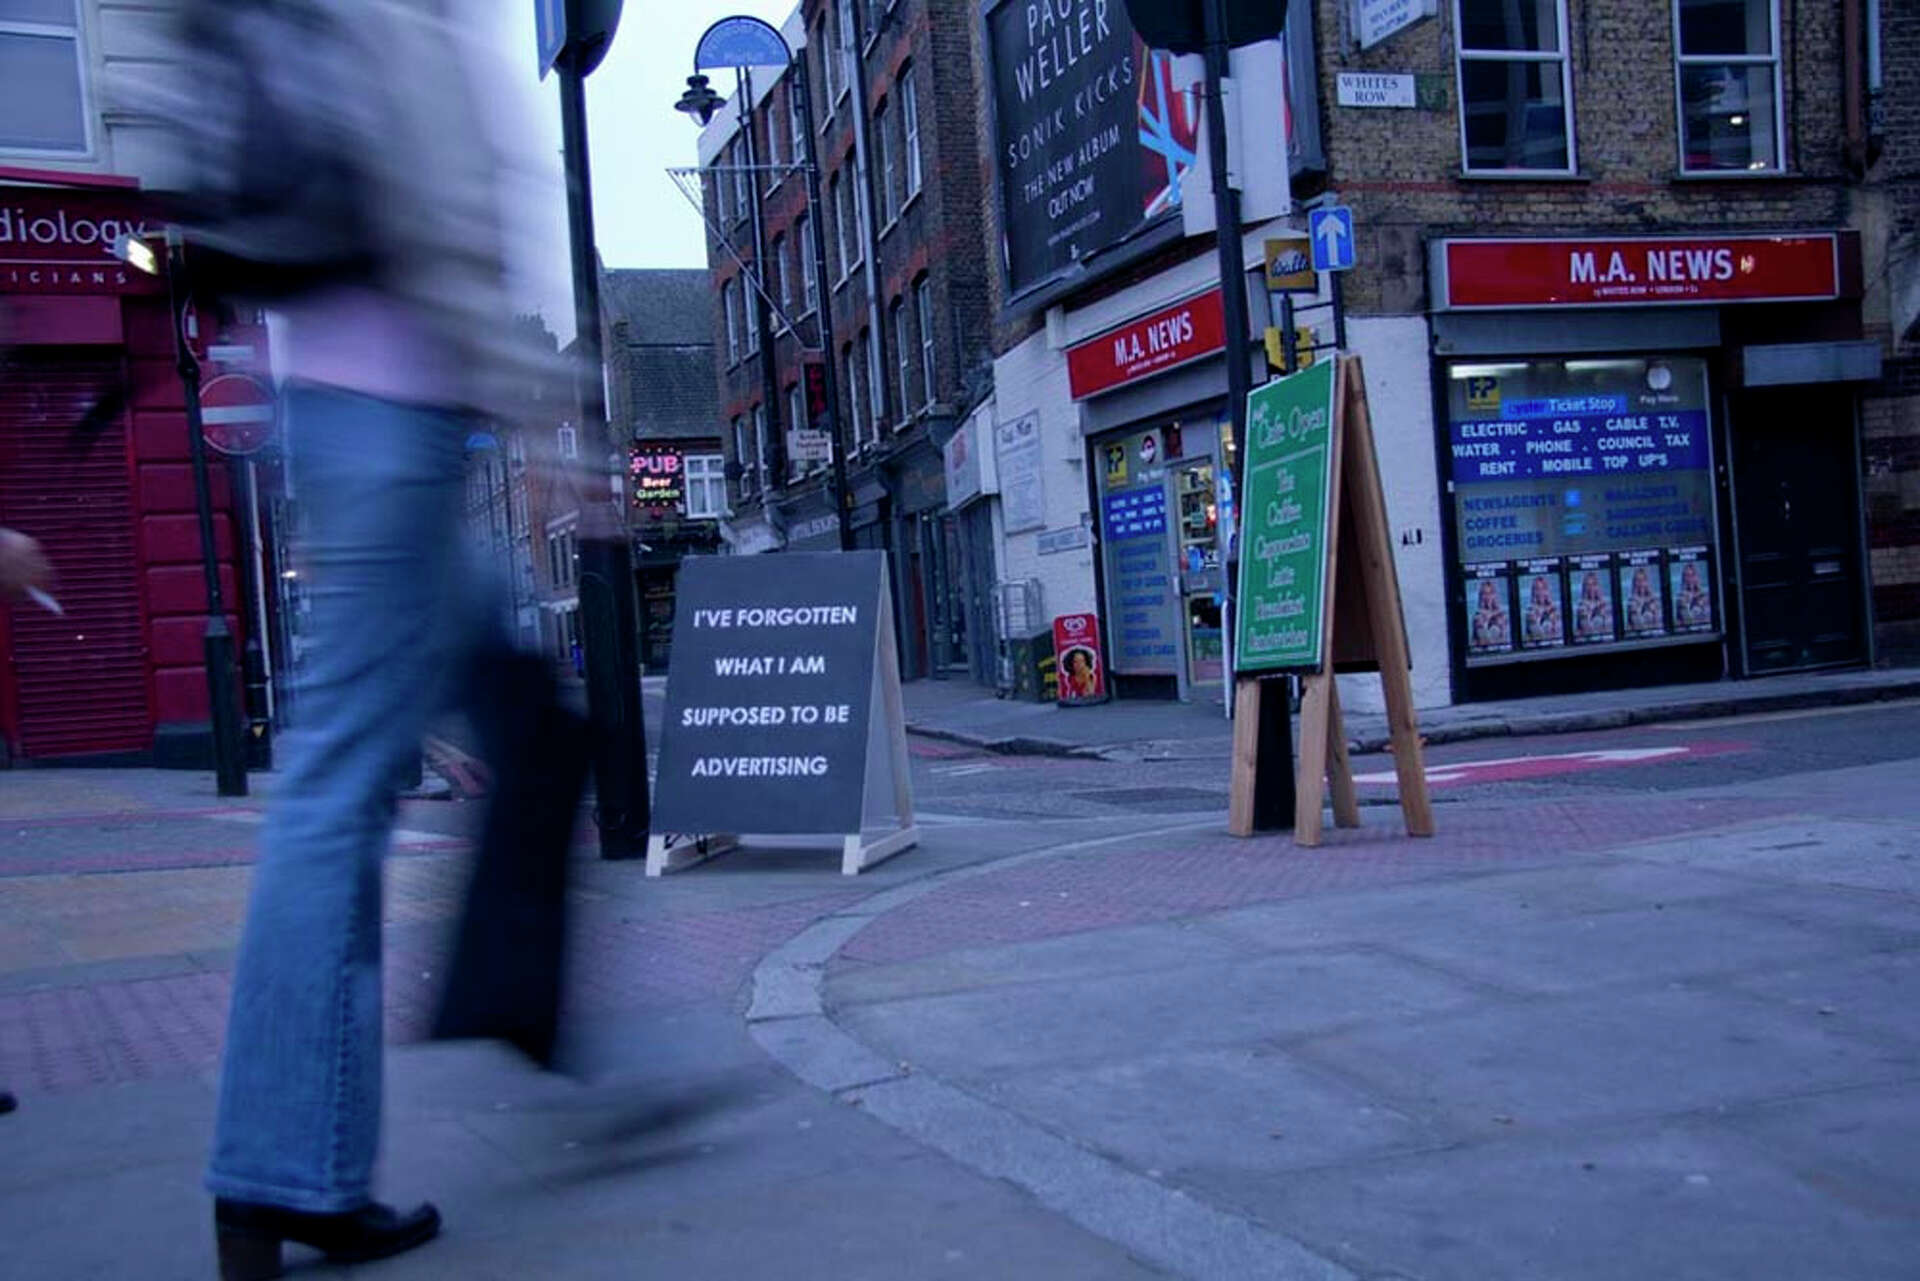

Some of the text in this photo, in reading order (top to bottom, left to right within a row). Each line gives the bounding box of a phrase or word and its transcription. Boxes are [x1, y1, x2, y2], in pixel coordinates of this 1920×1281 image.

[1027, 0, 1083, 47] PAU
[1015, 0, 1109, 103] WELLER
[1341, 77, 1399, 90] WHITES
[1354, 91, 1386, 103] ROW
[1008, 57, 1133, 169] SONIK KICKS
[1024, 123, 1120, 204] THE NEW ALBUM
[1569, 248, 1733, 283] M.A. NEWS
[1114, 333, 1145, 367] M.A.
[1147, 311, 1194, 354] NEWS
[1548, 398, 1586, 412] Ticket
[1590, 397, 1616, 412] Stop
[1289, 405, 1326, 442] Open
[1461, 416, 1680, 438] ELECTRIC GAS CABLE T.V.
[1452, 433, 1690, 457] WATER PHONE COUNCIL TAX
[632, 456, 679, 473] PUB
[1480, 460, 1516, 475] RENT
[1542, 457, 1593, 471] MOBILE
[1602, 455, 1629, 468] TOP
[642, 477, 673, 488] Beer
[636, 489, 681, 499] Garden
[1464, 515, 1516, 531] COFFEE
[1466, 531, 1544, 549] GROCERIES
[693, 606, 858, 628] I'VE FORGOTTEN
[714, 656, 826, 676] WHAT I AM
[681, 705, 850, 726] SUPPOSED TO BE
[691, 757, 829, 776] ADVERTISING
